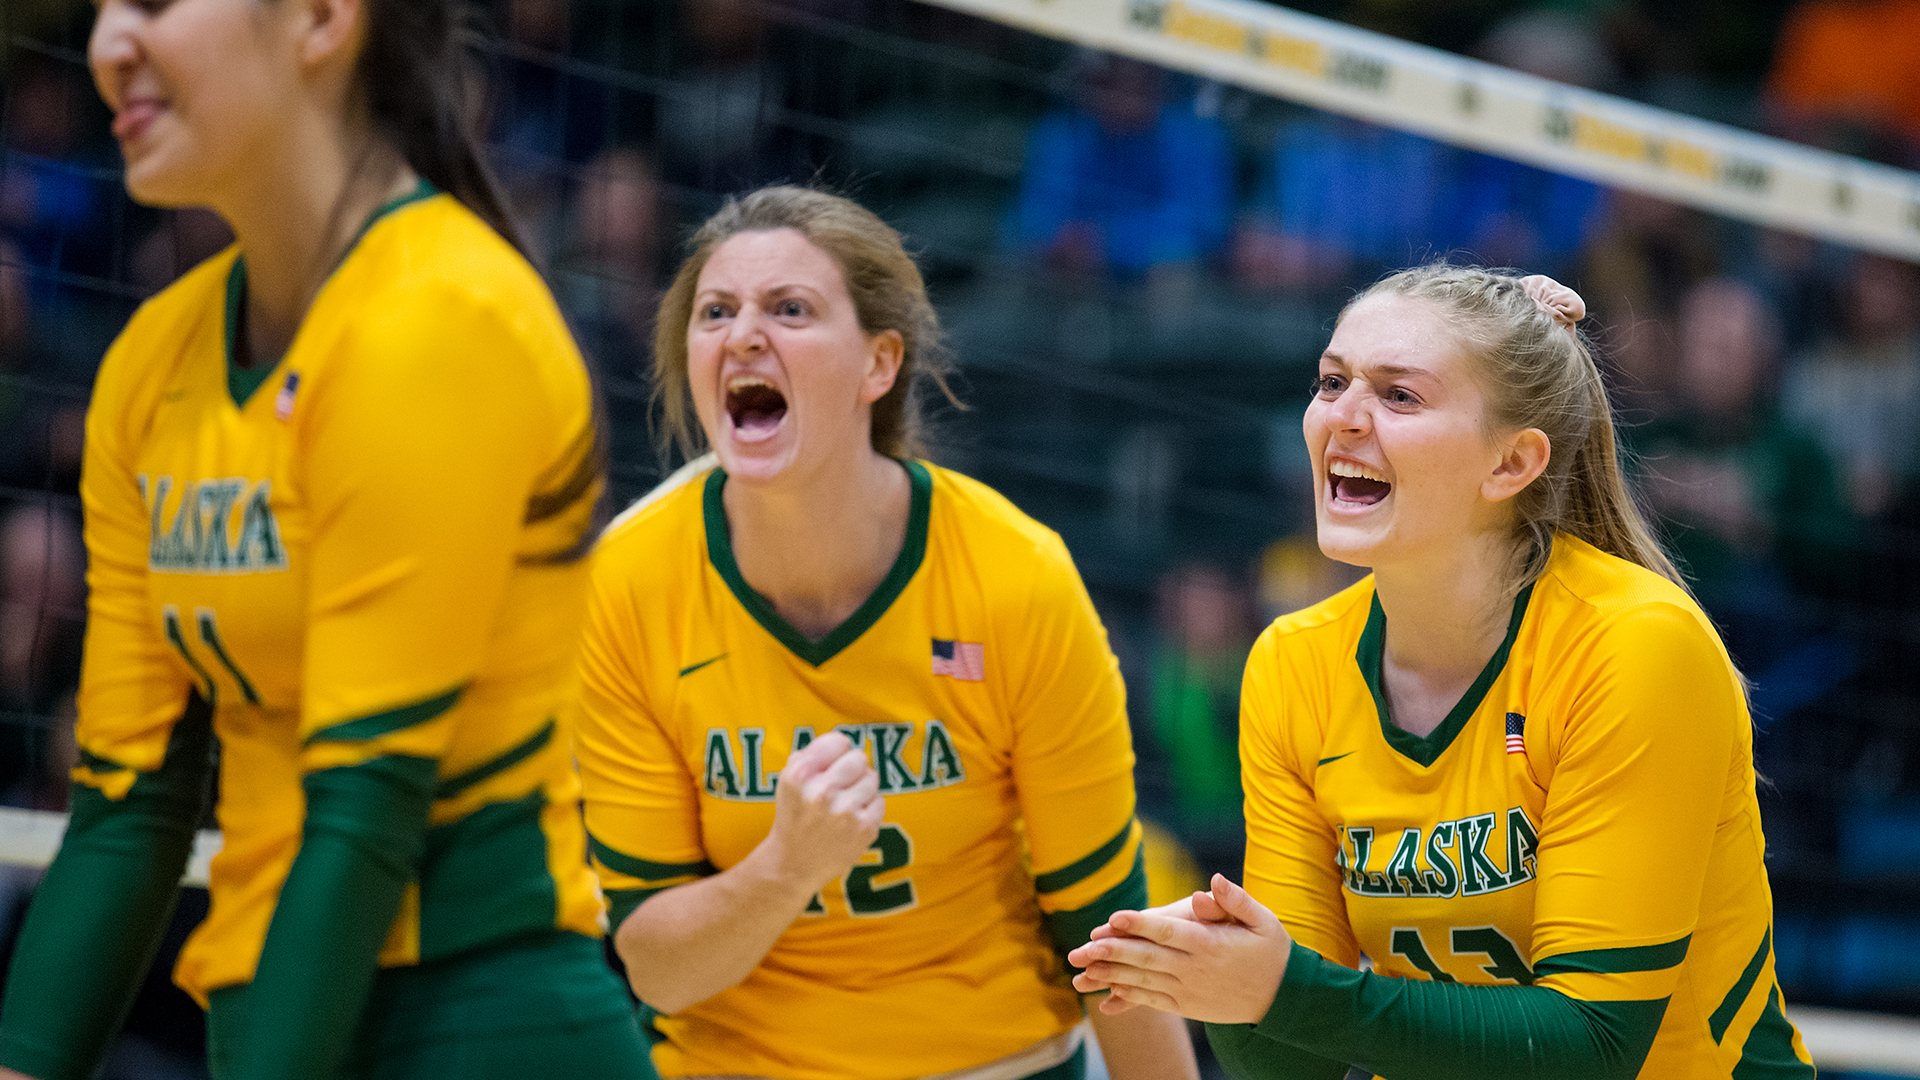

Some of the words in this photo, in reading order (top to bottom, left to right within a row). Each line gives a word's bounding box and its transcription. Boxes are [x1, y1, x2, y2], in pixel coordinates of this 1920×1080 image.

[136, 473, 290, 576] LASKA
[162, 604, 263, 705] 11
[704, 720, 966, 803] ALKA
[802, 822, 919, 918] 2
